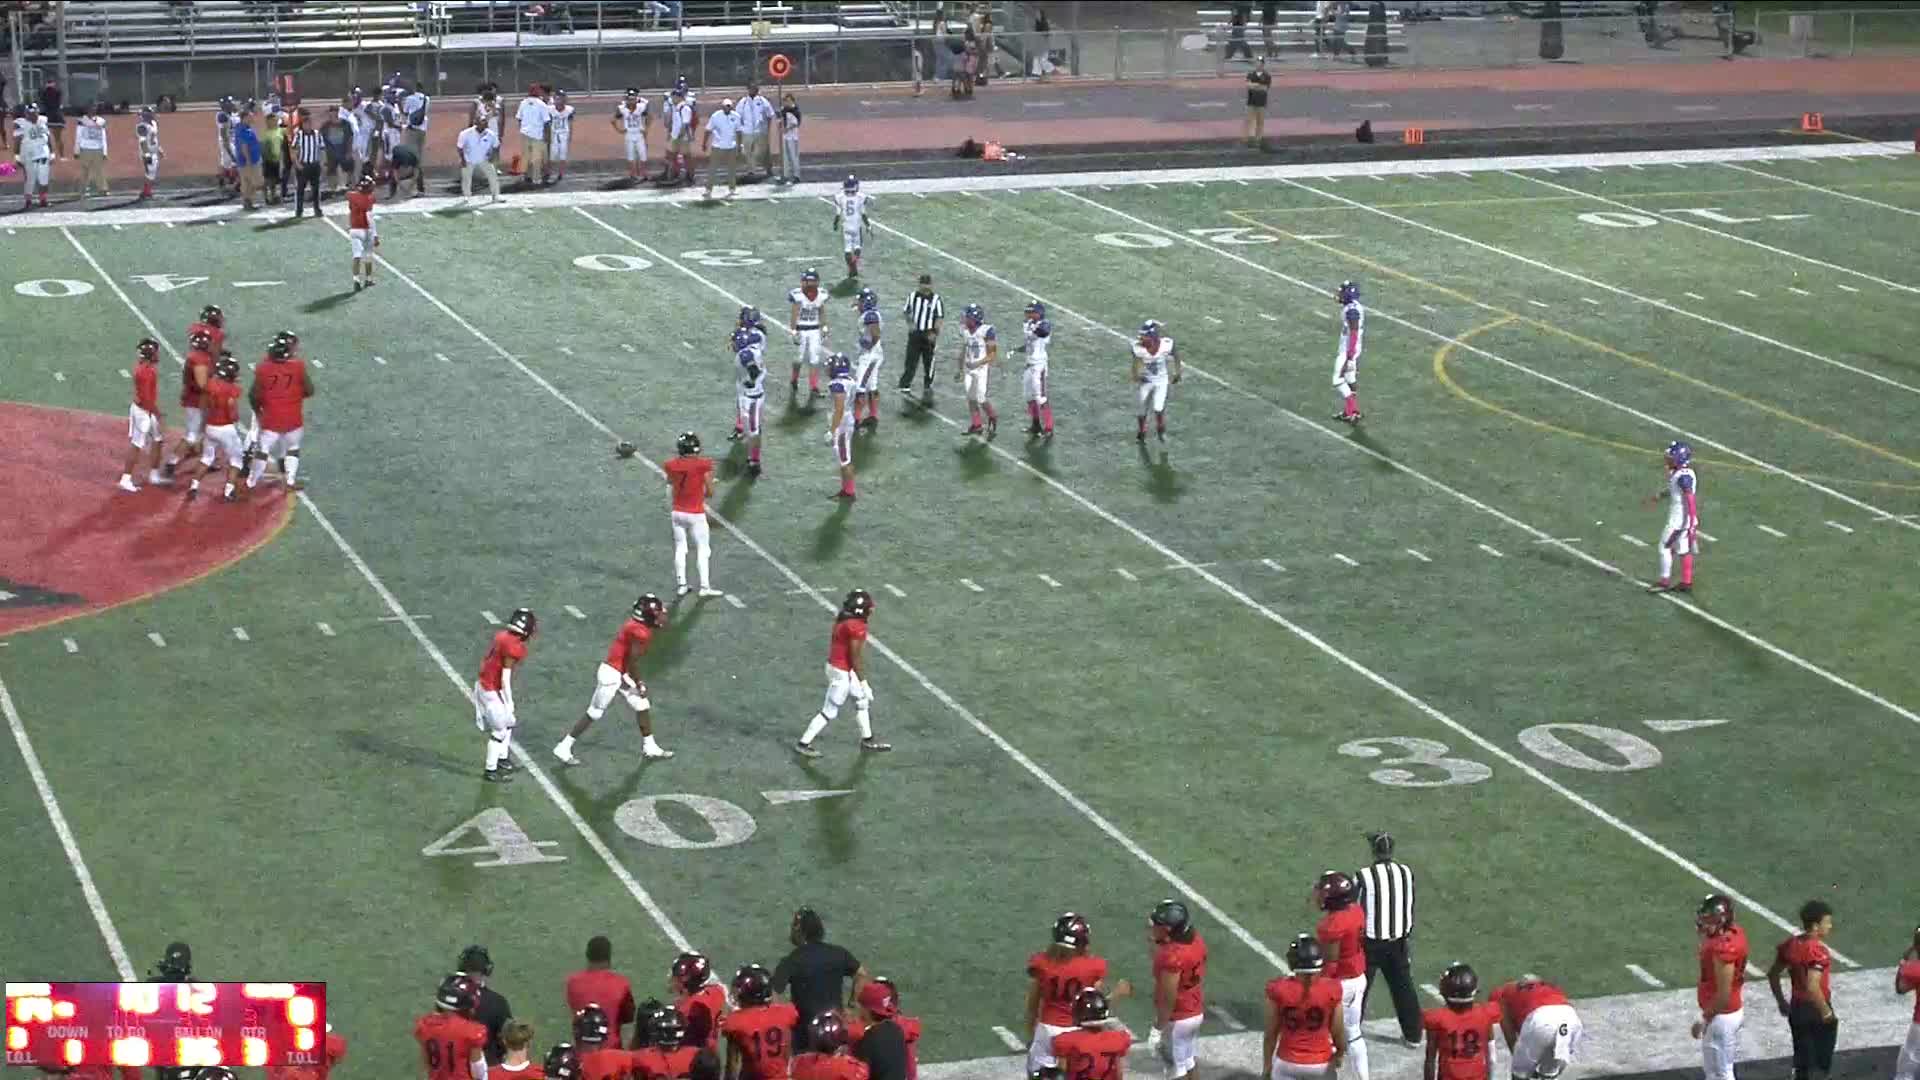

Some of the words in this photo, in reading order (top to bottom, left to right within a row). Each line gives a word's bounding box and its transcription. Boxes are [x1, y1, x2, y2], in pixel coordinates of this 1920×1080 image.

[678, 470, 691, 491] 7
[1337, 722, 1663, 789] 30
[422, 794, 757, 867] 40
[752, 1026, 784, 1057] 19
[1558, 1023, 1568, 1037] G
